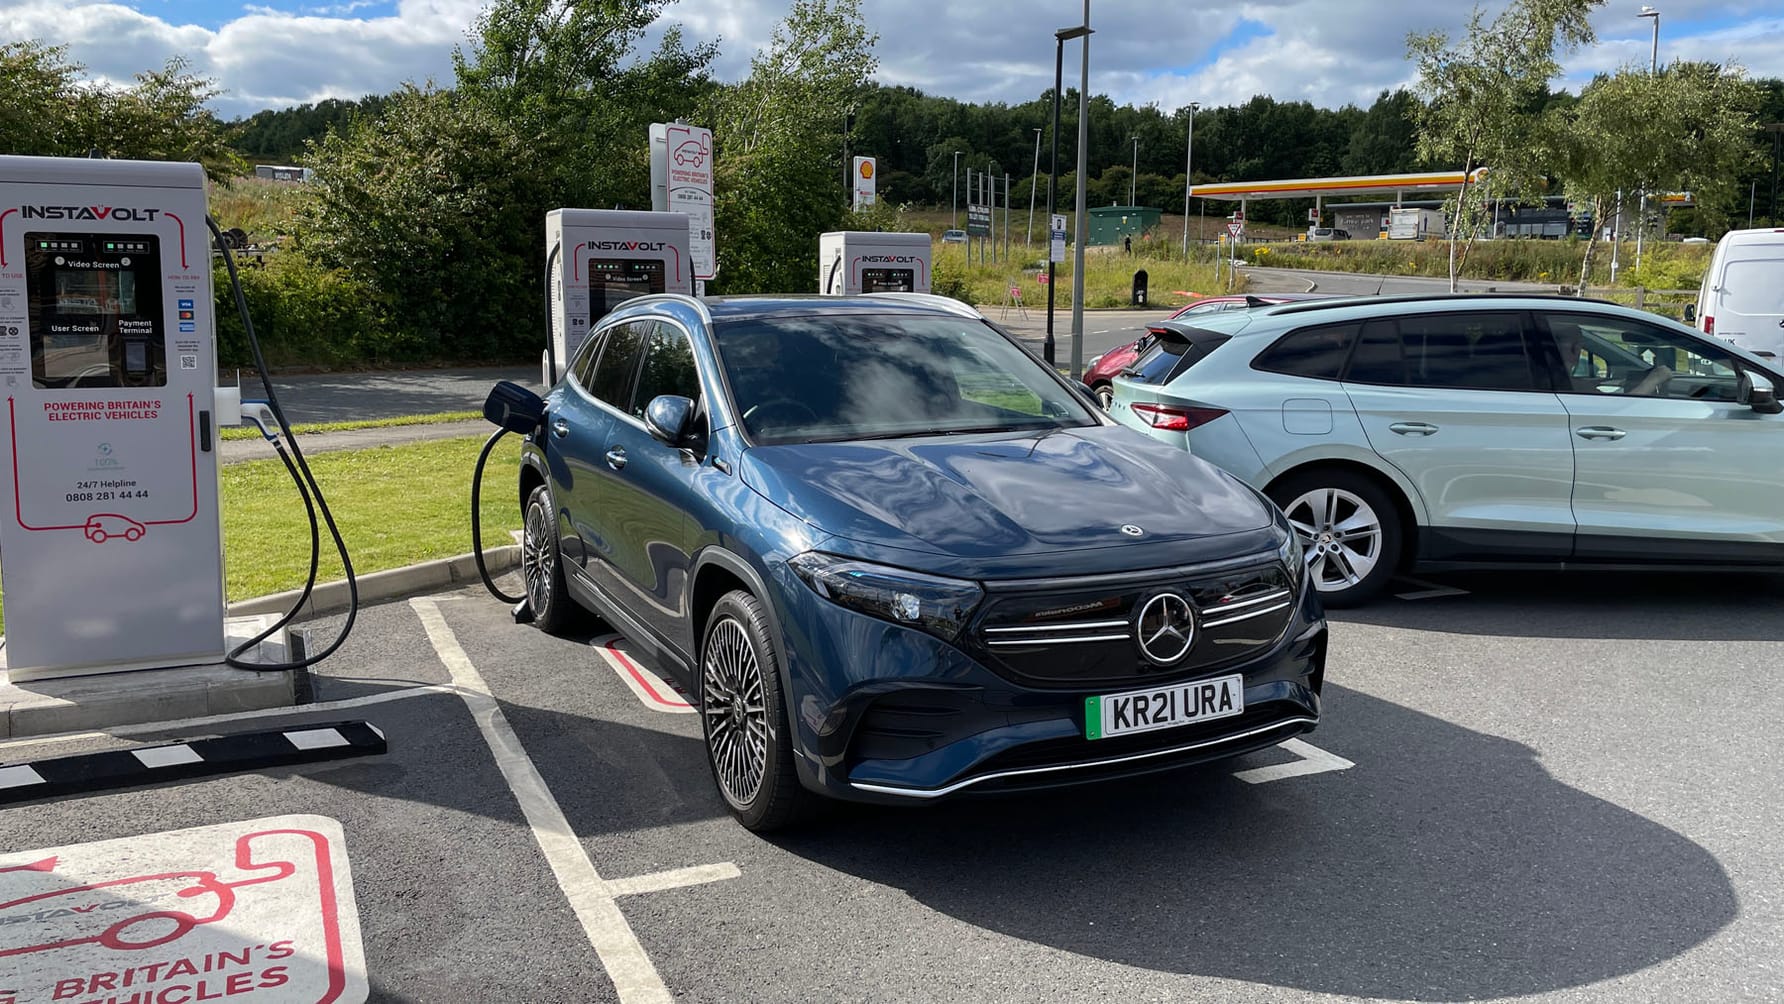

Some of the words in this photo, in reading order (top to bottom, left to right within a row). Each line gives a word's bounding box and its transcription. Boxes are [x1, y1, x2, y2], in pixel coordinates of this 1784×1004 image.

[22, 205, 160, 222] INSTAVOLT
[588, 241, 665, 251] INSTAVOLT
[862, 255, 915, 263] INSTAVOLT
[92, 261, 120, 269] Screen
[118, 320, 152, 328] Payment
[44, 401, 105, 411] POWERING
[108, 400, 161, 410] BRITAIN'S
[48, 411, 102, 421] ELECTRIC
[104, 410, 158, 420] VEHICLES
[77, 481, 98, 489] 24/7
[100, 480, 136, 490] Helpline
[66, 493, 93, 502] 0808
[96, 492, 115, 501] 281
[119, 491, 132, 499] 44
[135, 490, 149, 499] 44
[1113, 690, 1176, 730] KR21
[1183, 681, 1233, 718] URA
[53, 940, 295, 1000] BRITAIN'S
[80, 966, 289, 1004] HICLES
